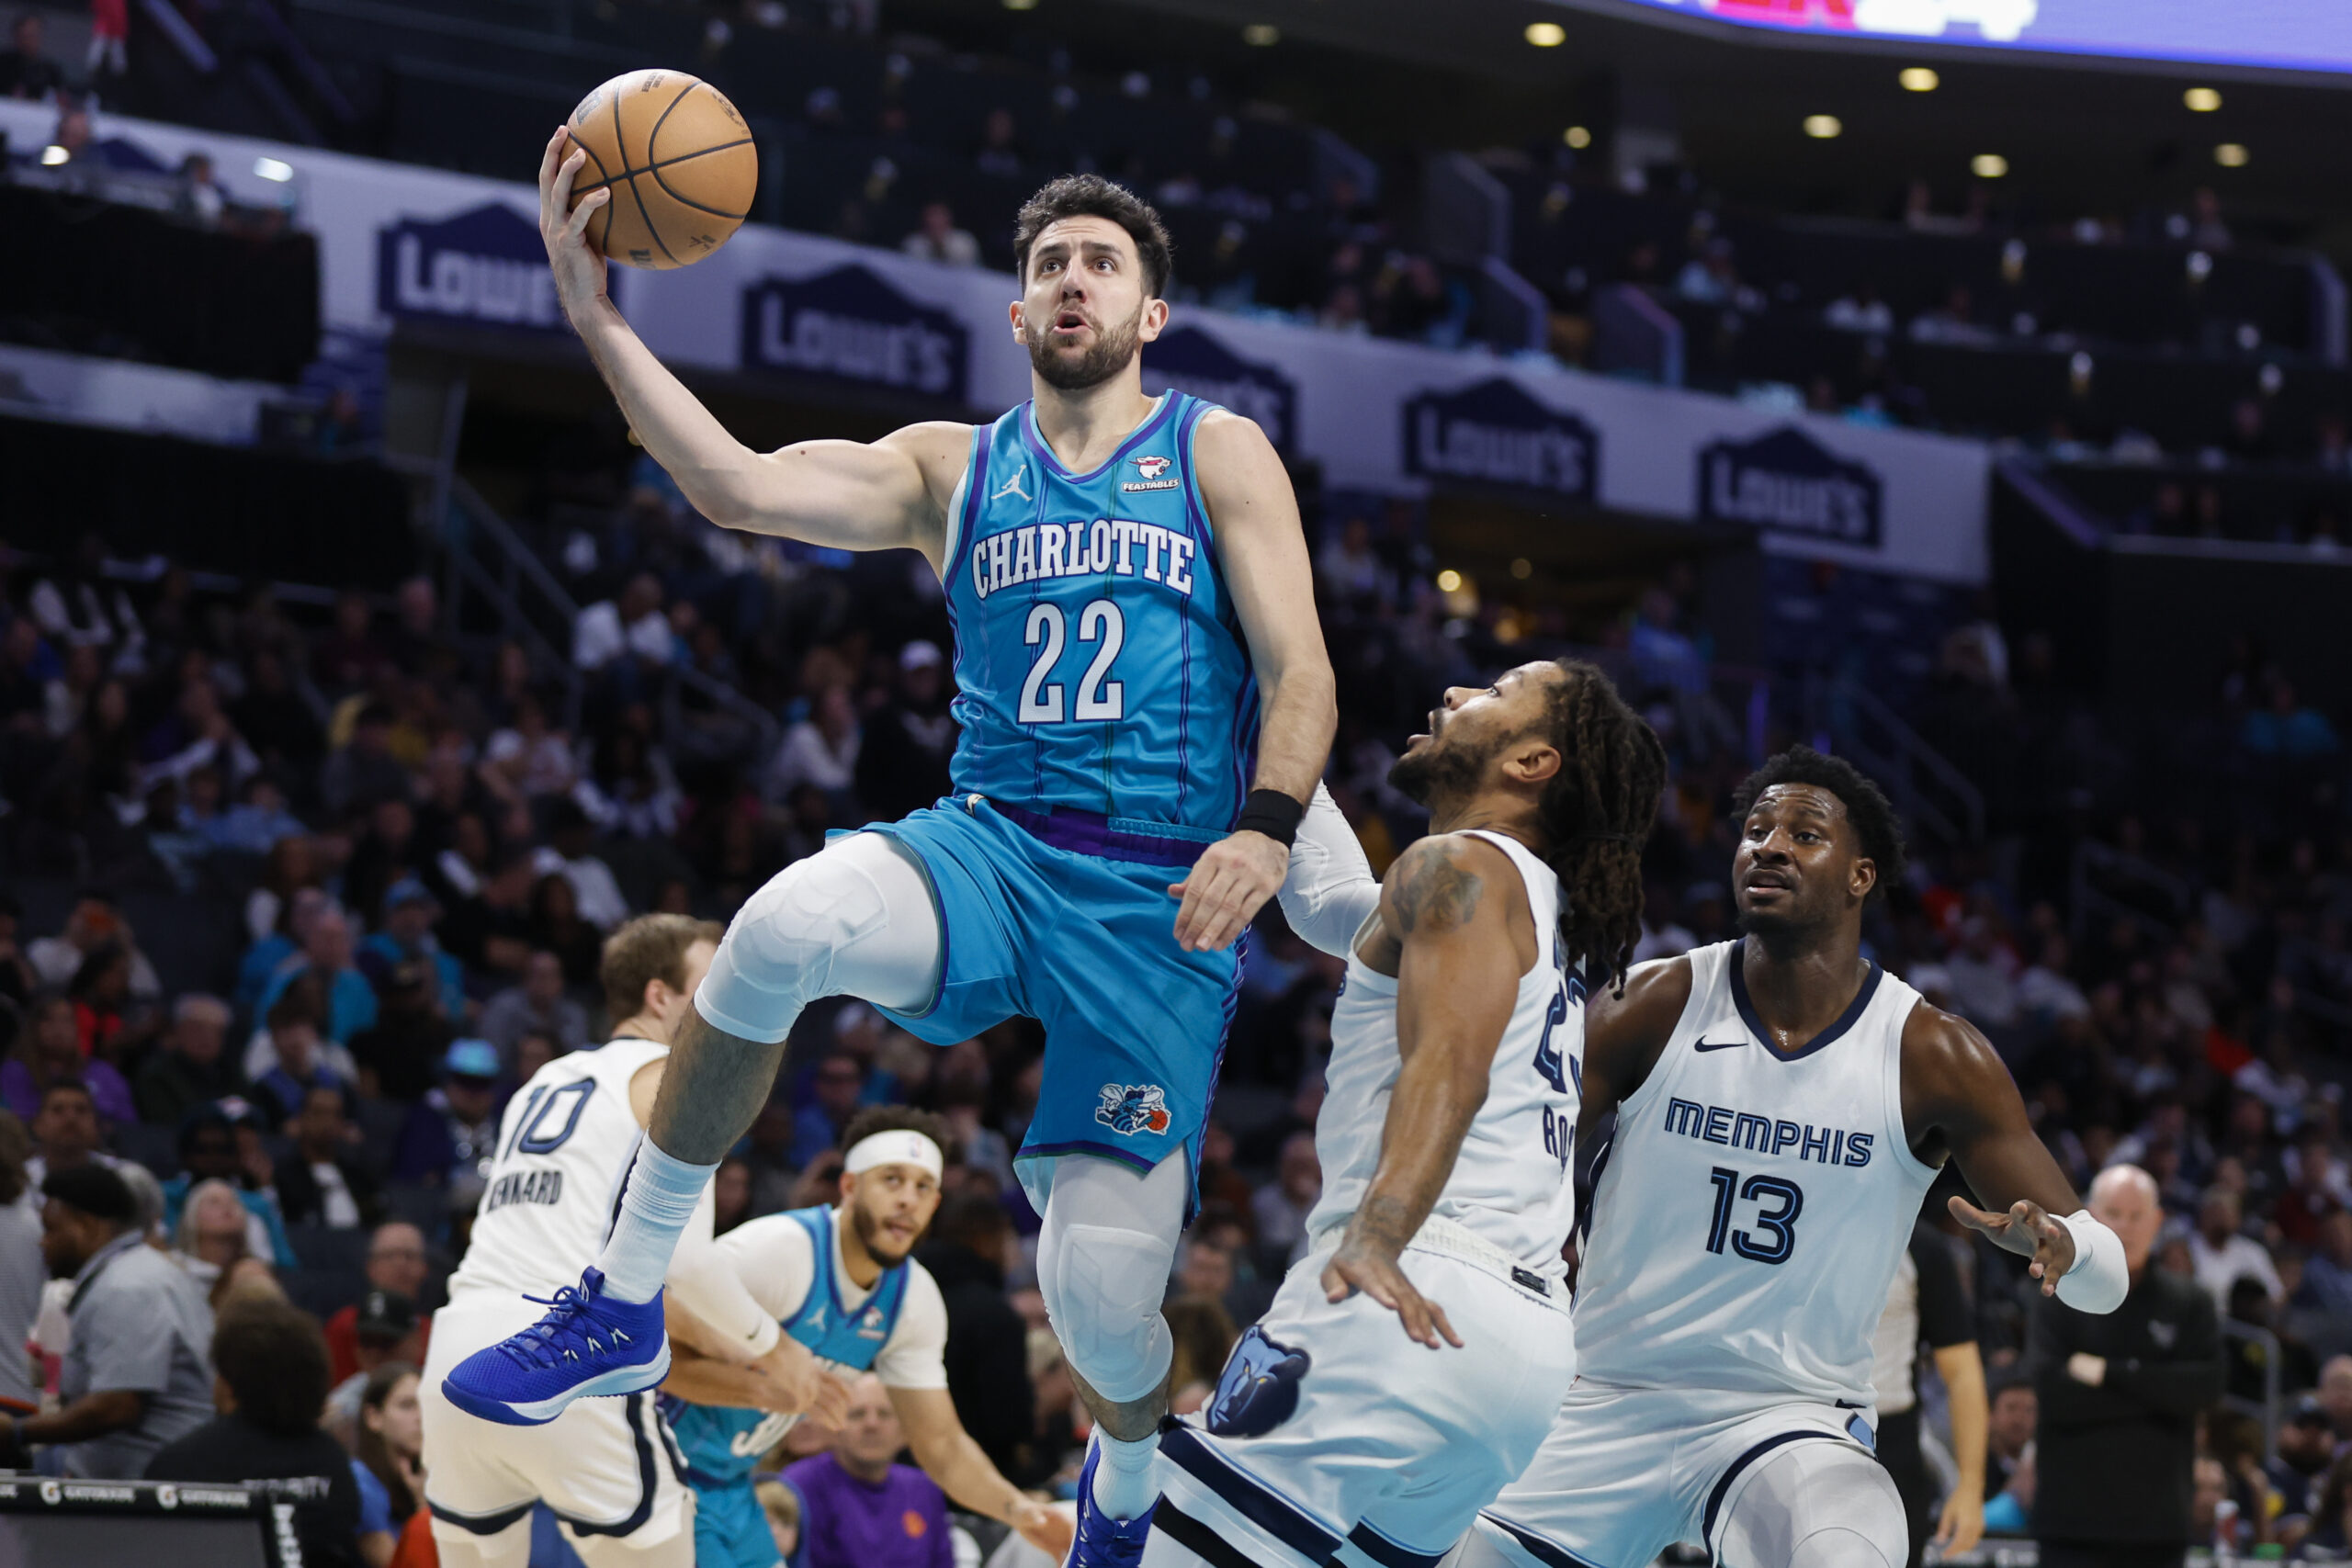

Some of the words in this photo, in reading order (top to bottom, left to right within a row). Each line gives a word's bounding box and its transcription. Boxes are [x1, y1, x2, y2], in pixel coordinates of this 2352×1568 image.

[1122, 478, 1180, 492] FEASTABLES
[972, 518, 1195, 600] CHARLOTTE
[1017, 598, 1125, 725] 22
[504, 1077, 596, 1161] 10
[1664, 1097, 1874, 1168] MEMPHIS
[1706, 1167, 1804, 1265] 13
